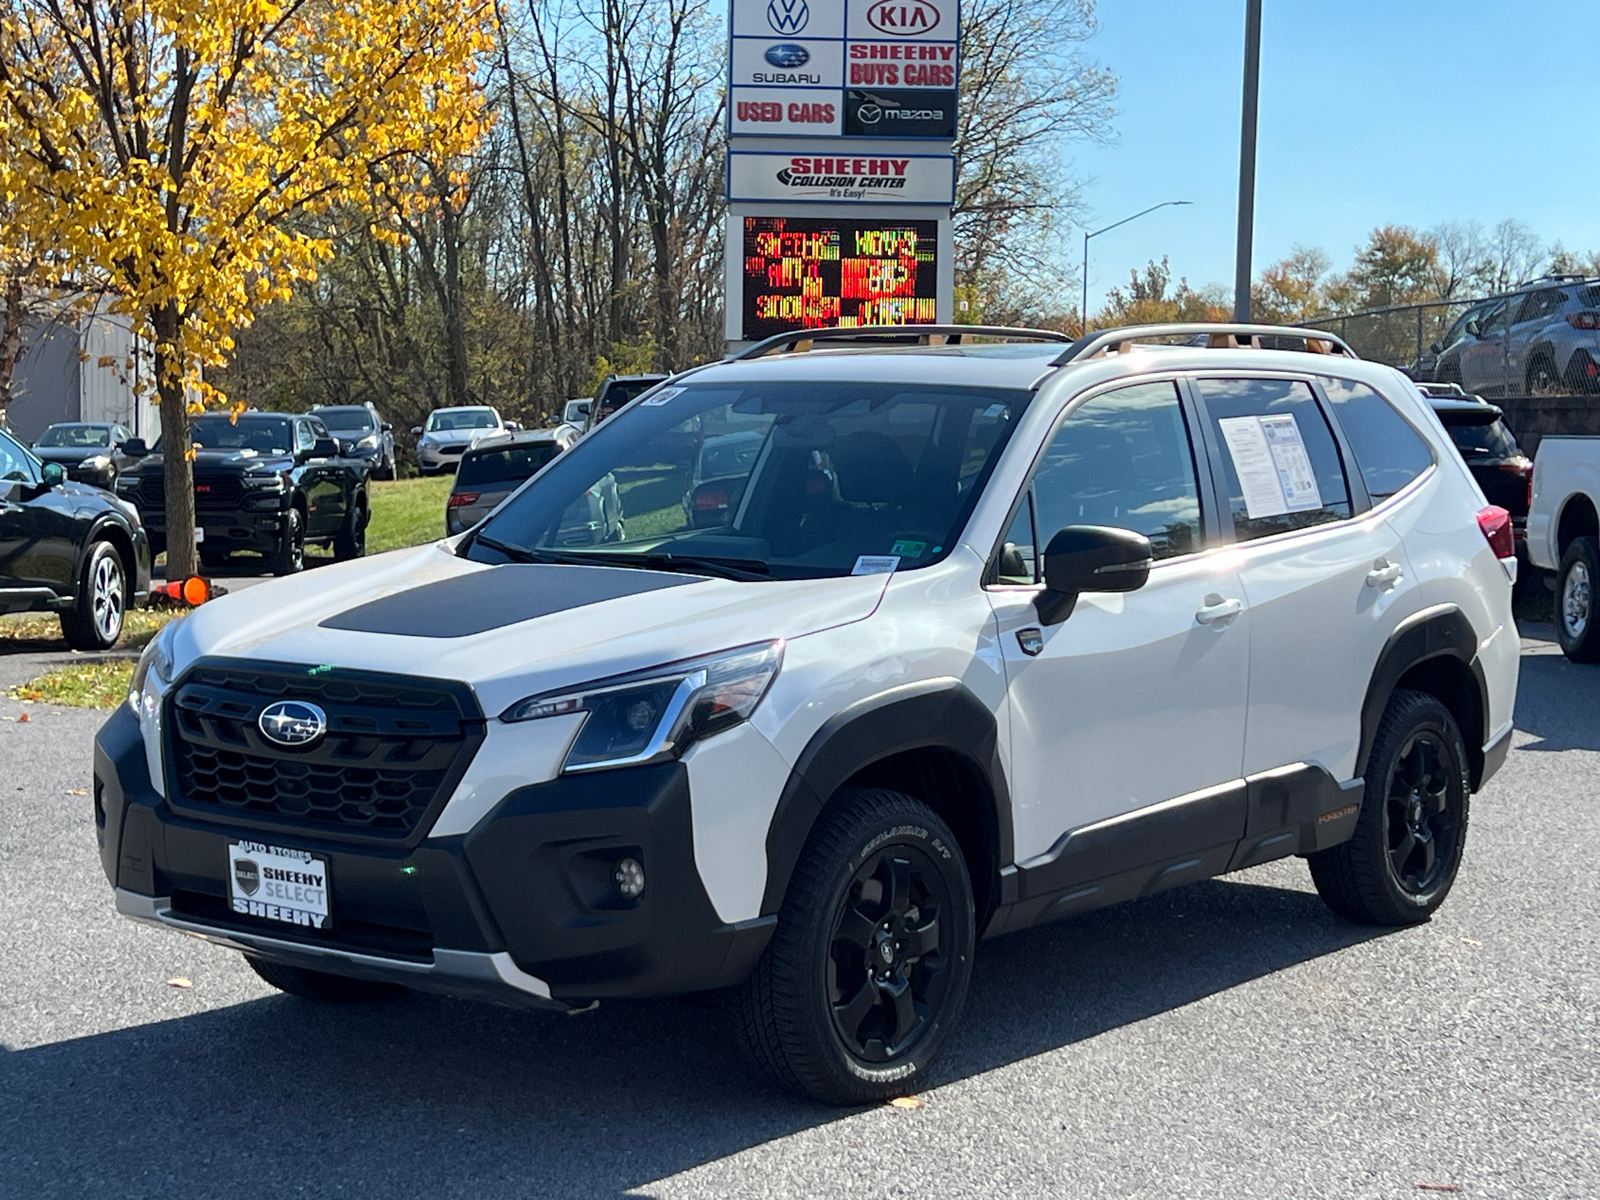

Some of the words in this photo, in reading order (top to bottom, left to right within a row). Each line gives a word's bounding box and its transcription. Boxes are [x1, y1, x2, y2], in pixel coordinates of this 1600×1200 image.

[880, 6, 928, 27] KIA
[849, 45, 955, 60] SHEEHY
[752, 72, 821, 84] SUBARU
[850, 63, 898, 85] BUYS
[904, 64, 955, 86] CARS
[737, 101, 783, 122] USED
[788, 103, 835, 124] CARS
[790, 158, 910, 175] SHEEHY
[790, 175, 857, 187] COLLISION
[858, 177, 906, 188] CENTER
[829, 188, 842, 198] It's
[843, 189, 866, 200] Easy!
[237, 840, 266, 853] AUTO
[269, 846, 312, 861] STORES
[236, 870, 259, 880] SELECT
[263, 867, 323, 887] SHEEHY
[265, 881, 324, 906] SELECT
[232, 898, 326, 929] SHEEHY
